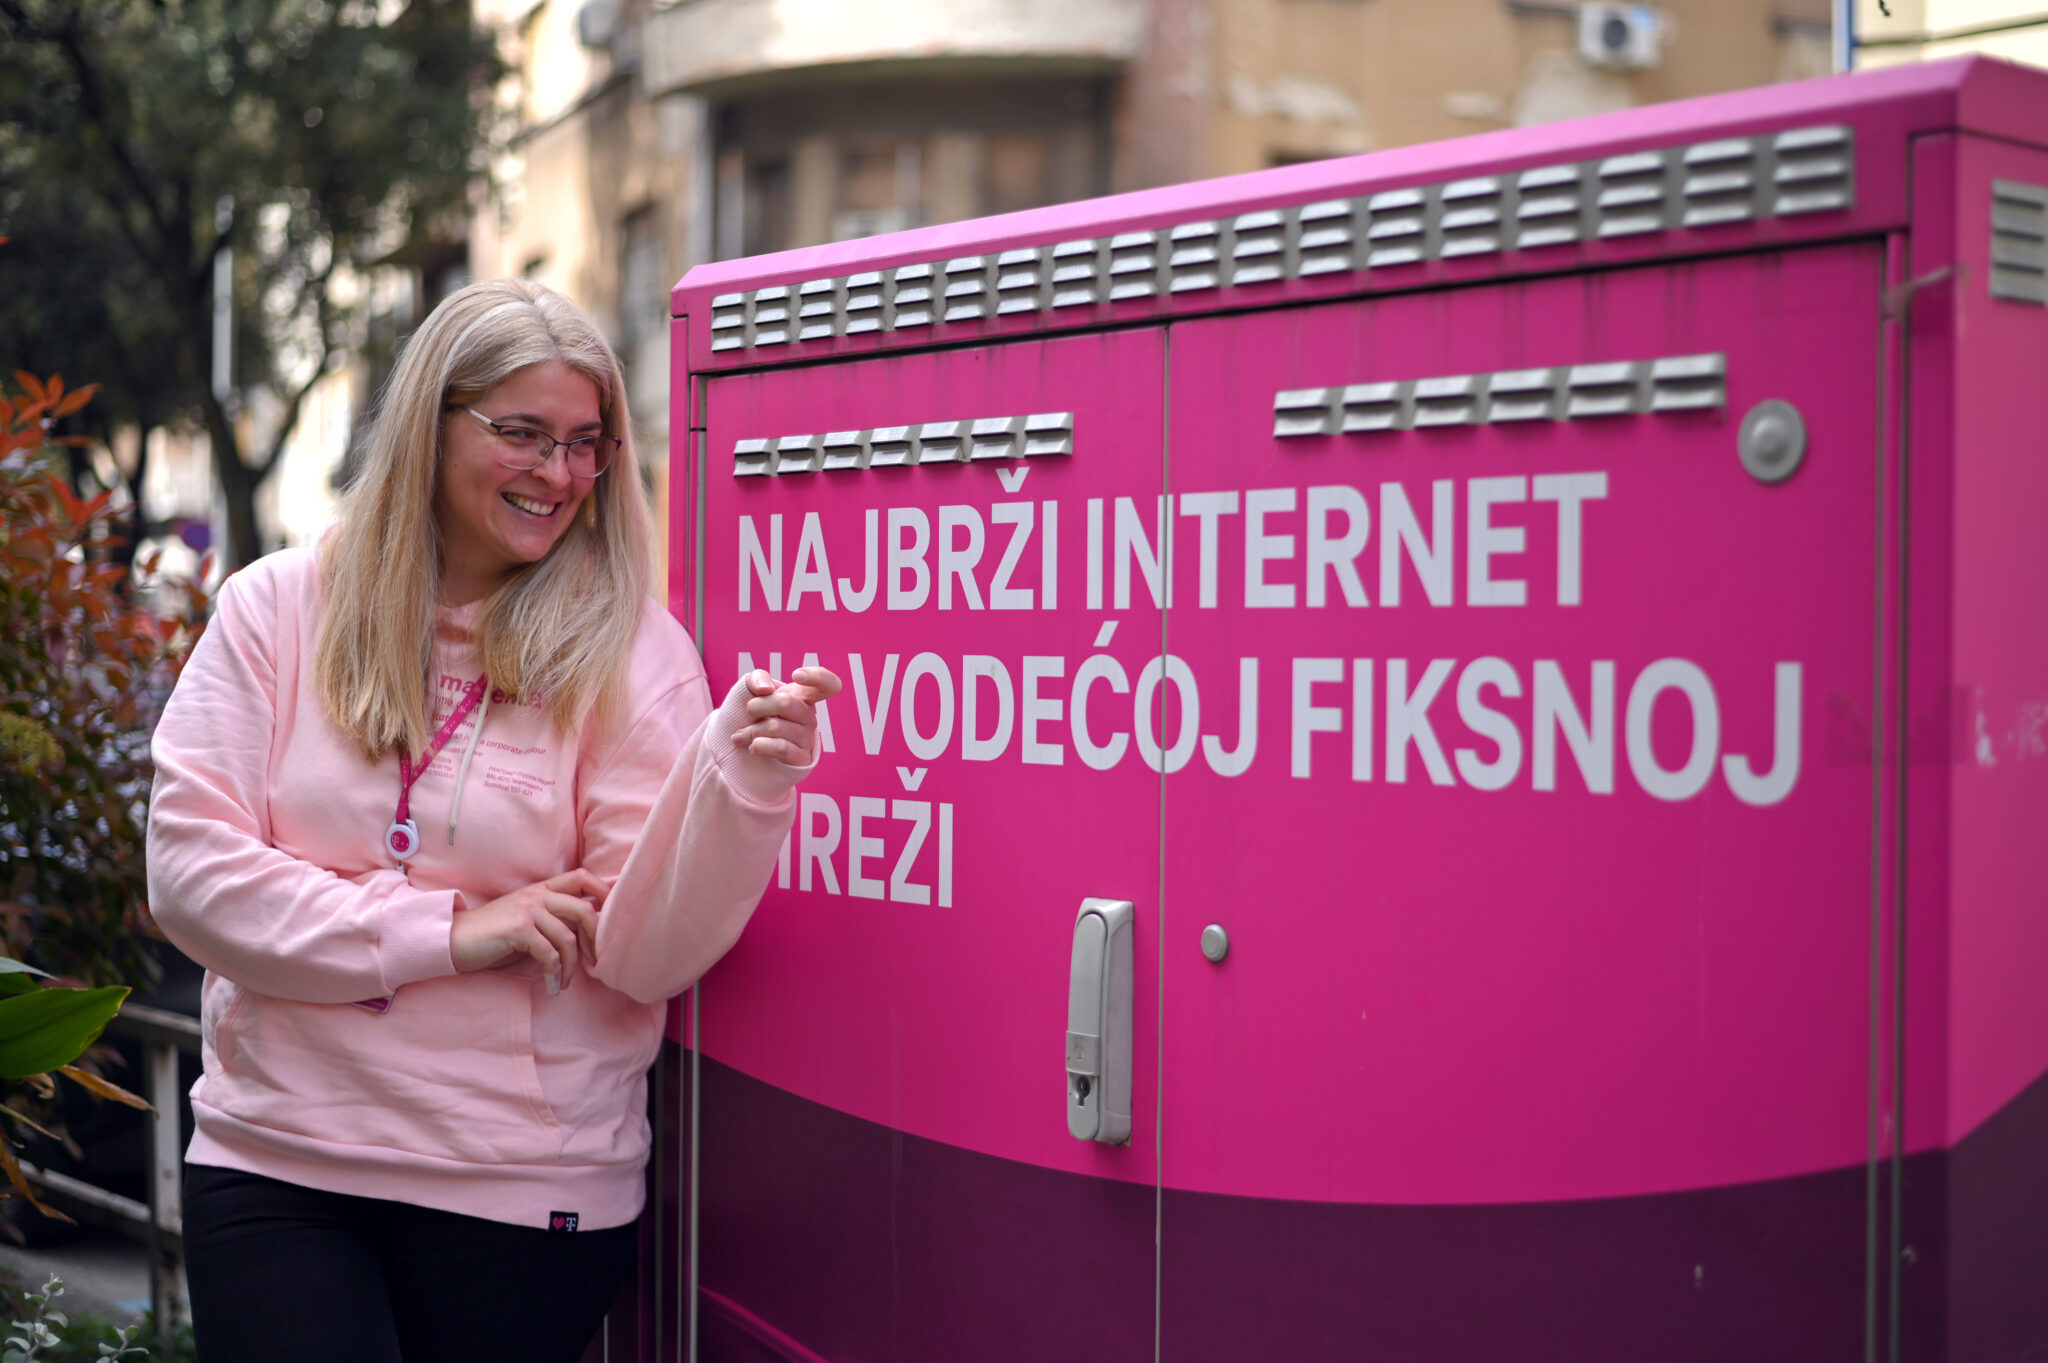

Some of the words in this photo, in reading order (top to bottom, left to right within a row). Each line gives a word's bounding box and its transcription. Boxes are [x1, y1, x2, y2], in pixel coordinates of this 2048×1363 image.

[738, 467, 1058, 613] NAJBRŽI
[1086, 471, 1608, 610] INTERNET
[486, 740, 524, 756] corporate
[847, 620, 1259, 778] VODEĆOJ
[1291, 656, 1803, 806] FIKSNOJ
[778, 766, 954, 910] REŽI
